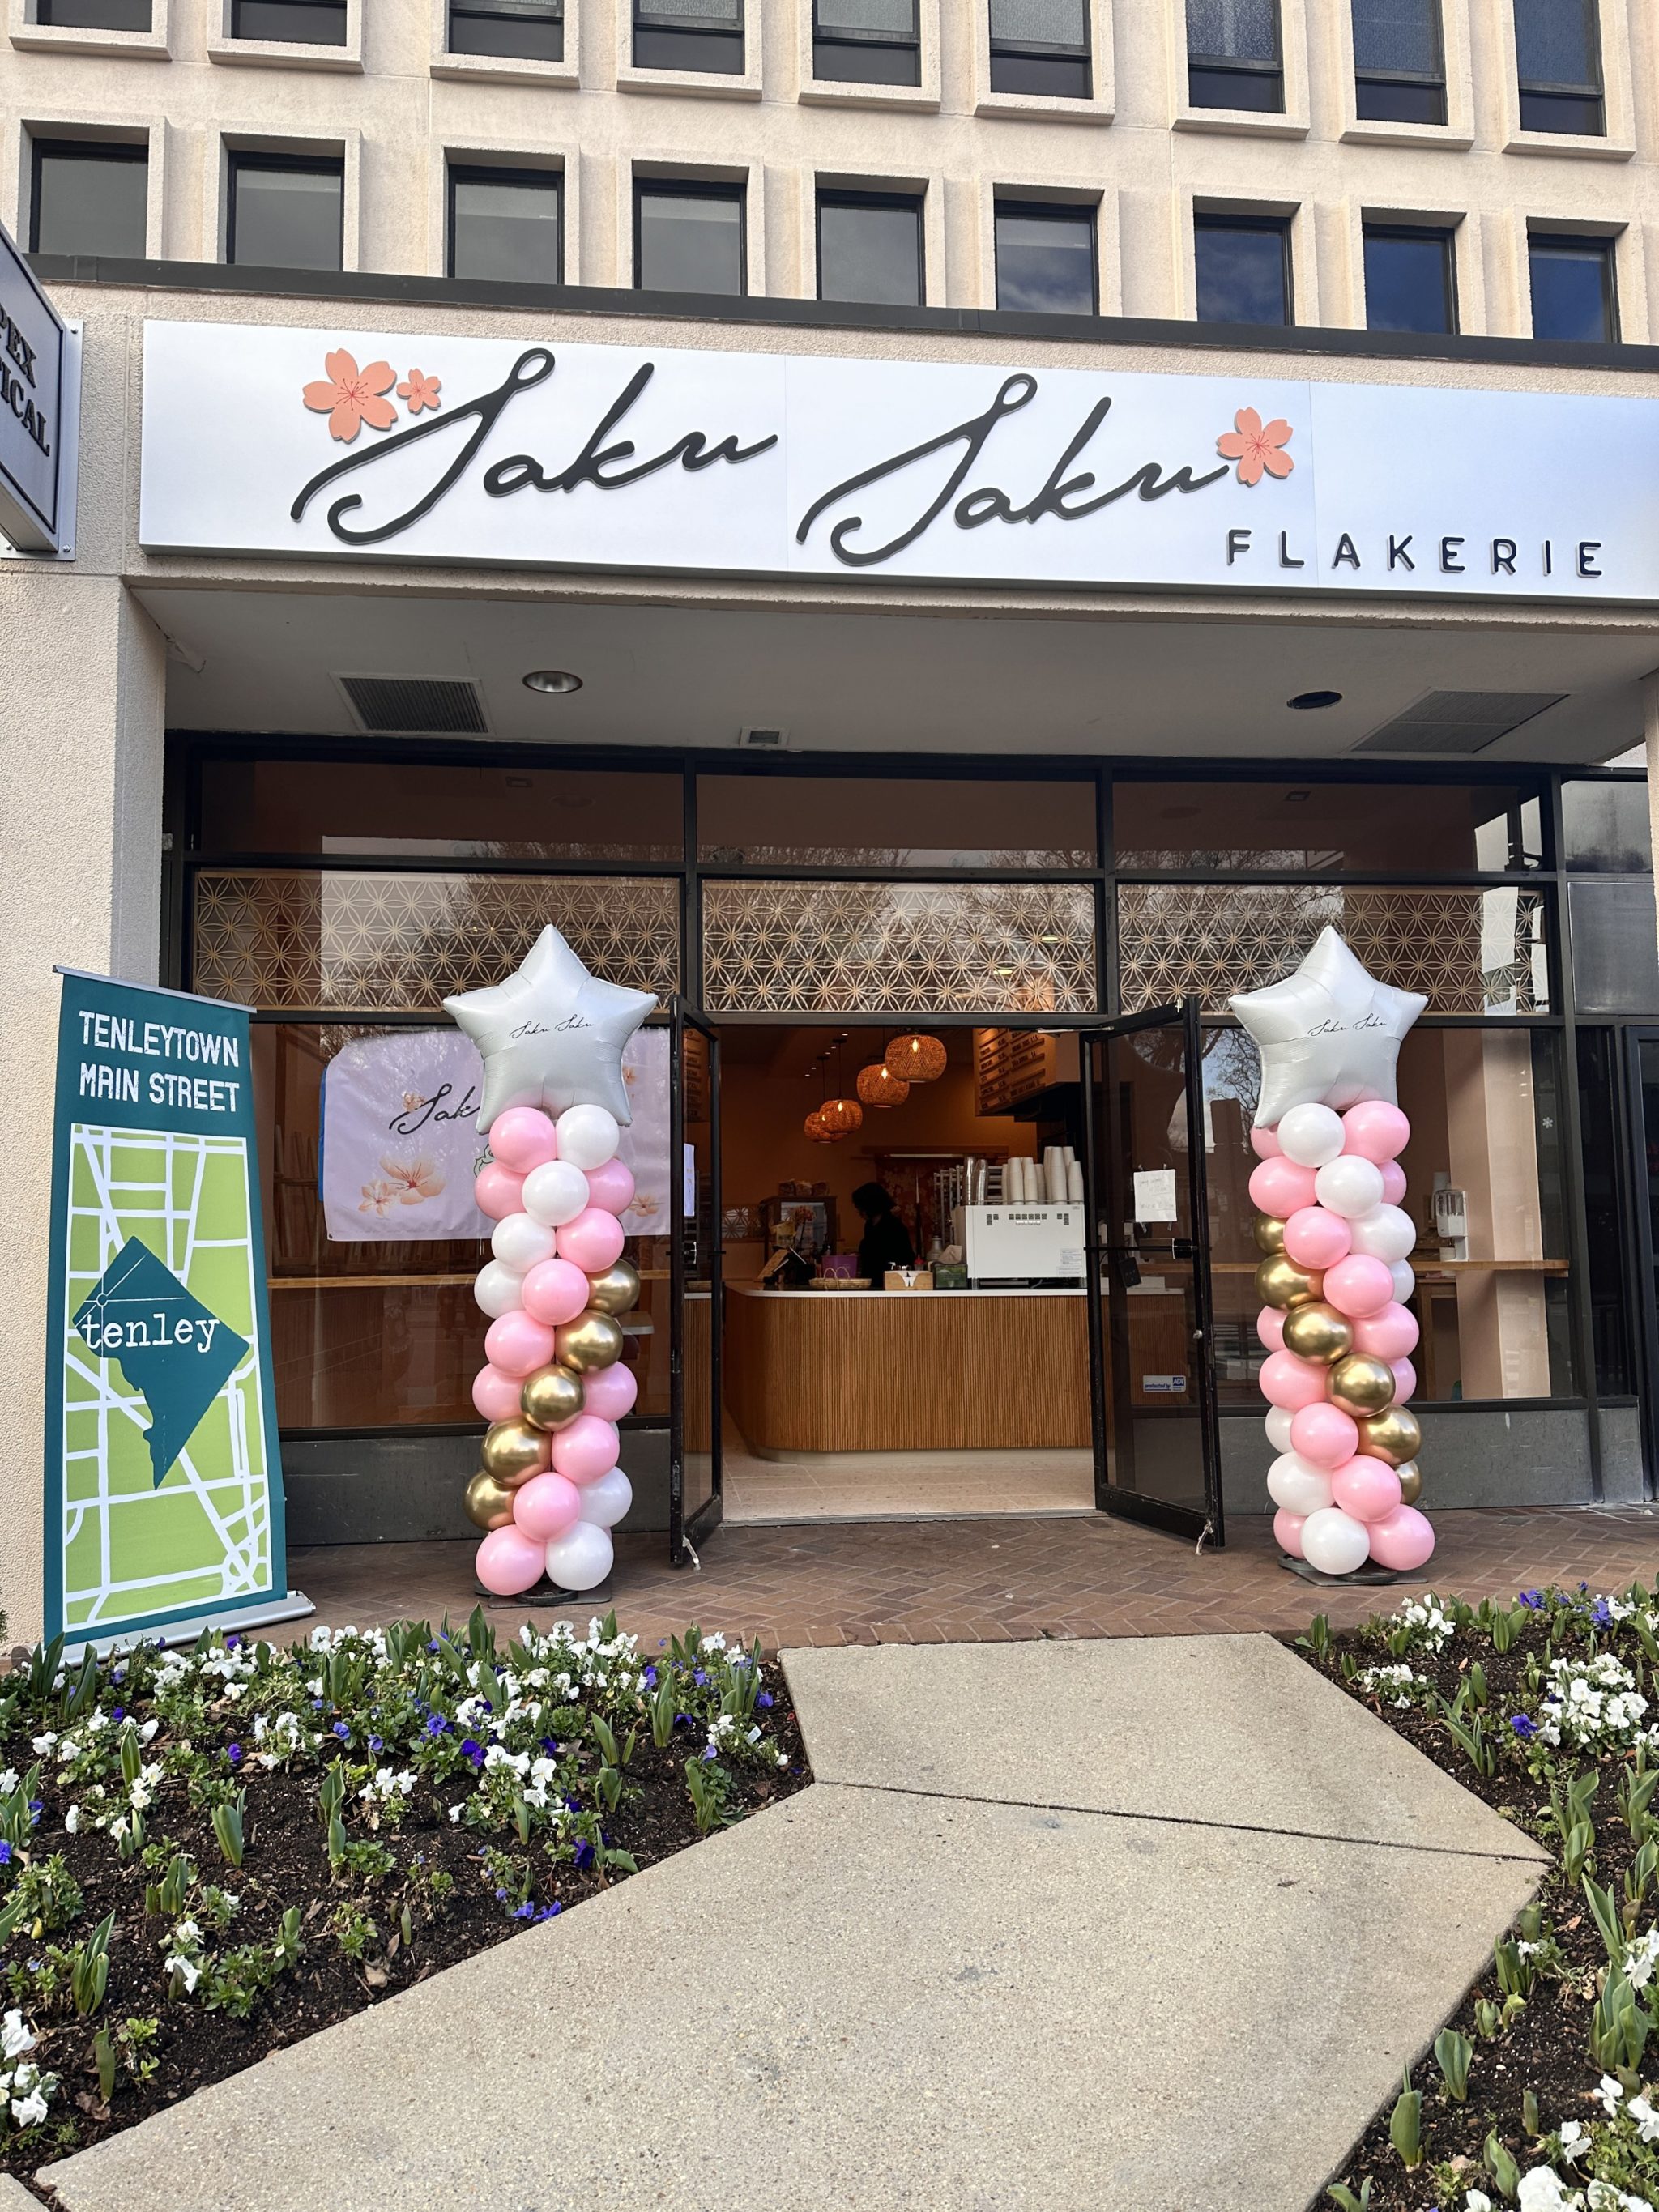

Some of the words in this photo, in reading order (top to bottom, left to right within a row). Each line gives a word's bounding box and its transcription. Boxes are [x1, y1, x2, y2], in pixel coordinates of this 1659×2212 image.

[0, 355, 50, 457] ICAL
[1226, 528, 1603, 578] FLAKERIE
[79, 1010, 240, 1068] TENLEYTOWN
[79, 1062, 139, 1103] MAIN
[149, 1072, 240, 1113] STREET
[389, 1083, 480, 1134] Sak
[80, 1313, 220, 1353] tenley
